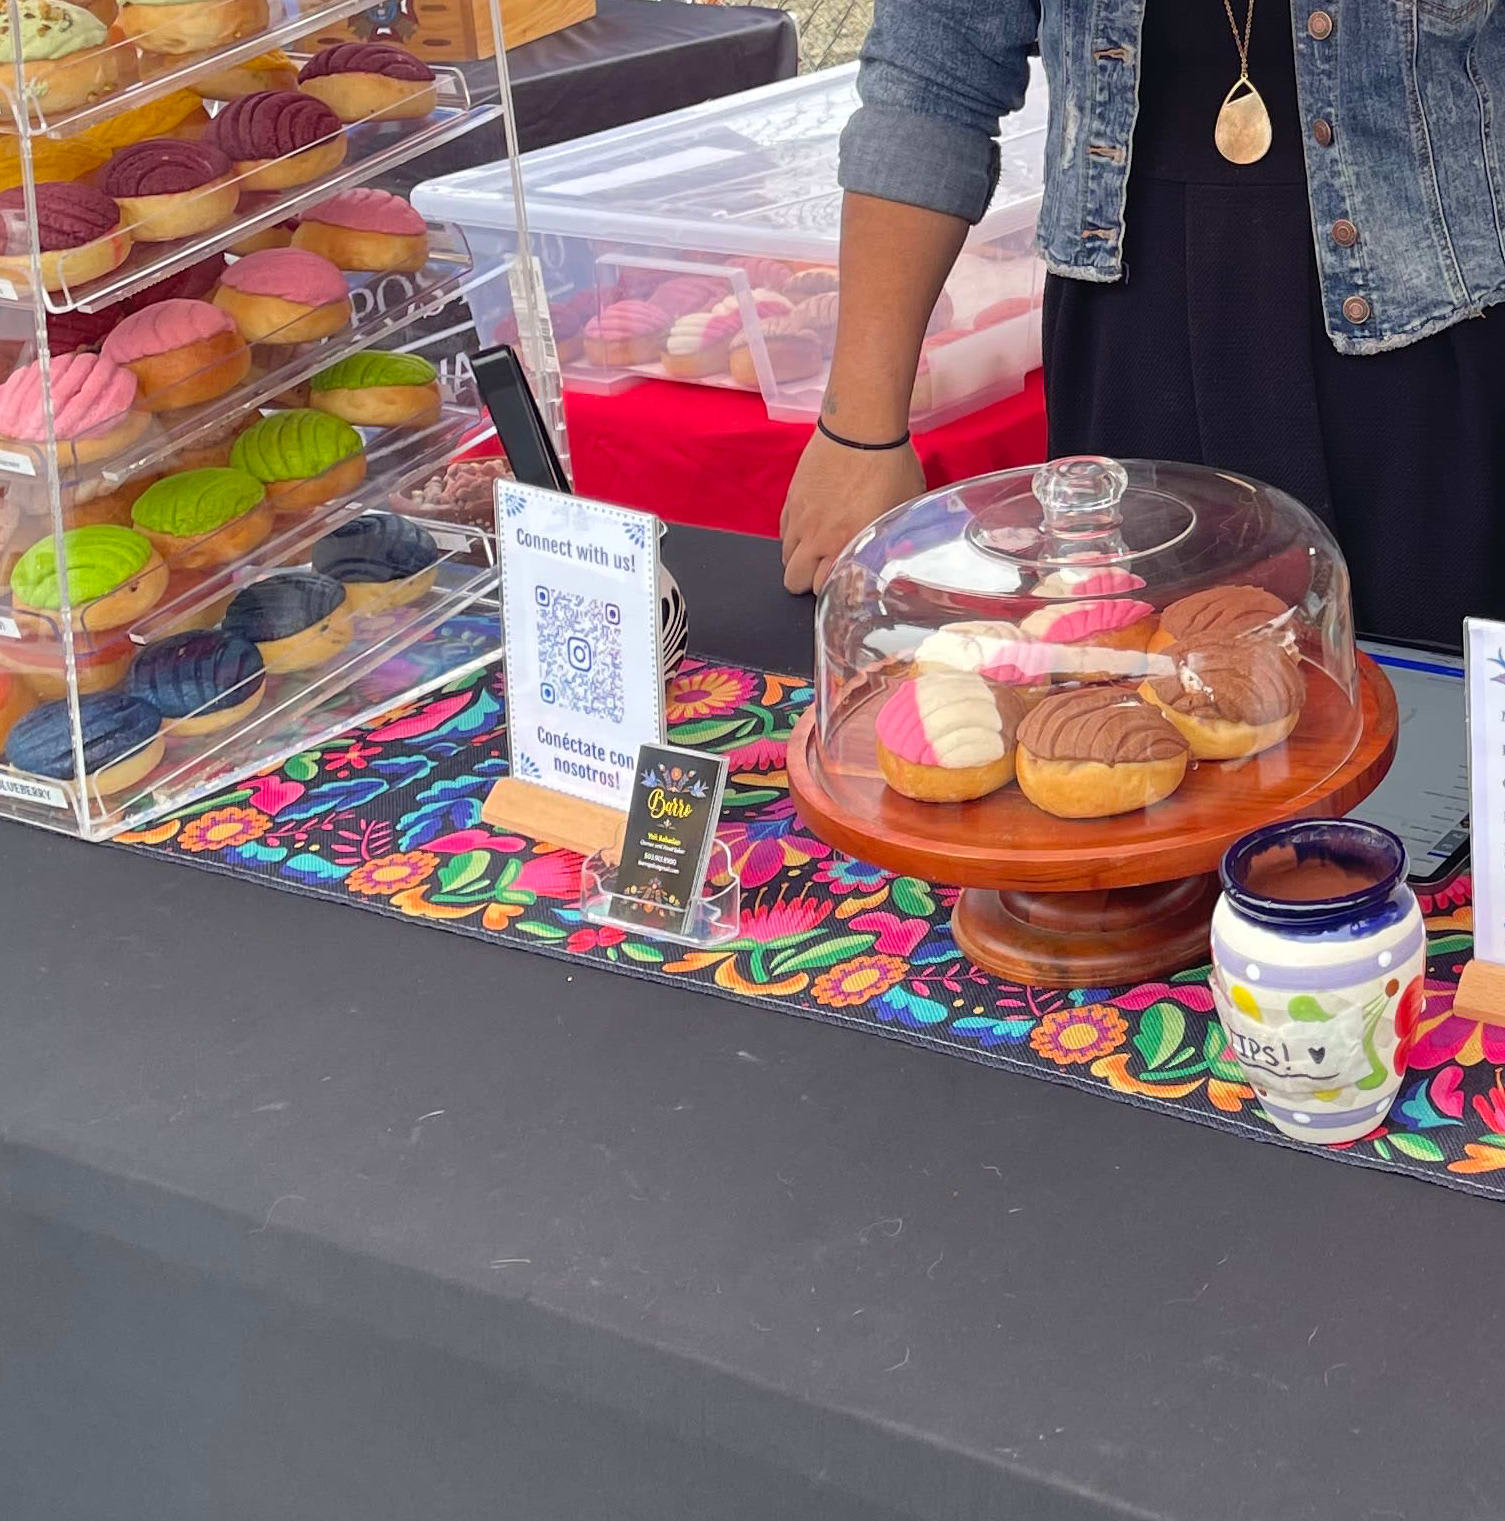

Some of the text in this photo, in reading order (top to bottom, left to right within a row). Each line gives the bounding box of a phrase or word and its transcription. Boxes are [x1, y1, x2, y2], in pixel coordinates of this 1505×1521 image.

[516, 527, 636, 573] Connect with us!
[537, 726, 635, 771] Conéctate con
[554, 757, 620, 790] nosotros!
[647, 787, 694, 819] Barro
